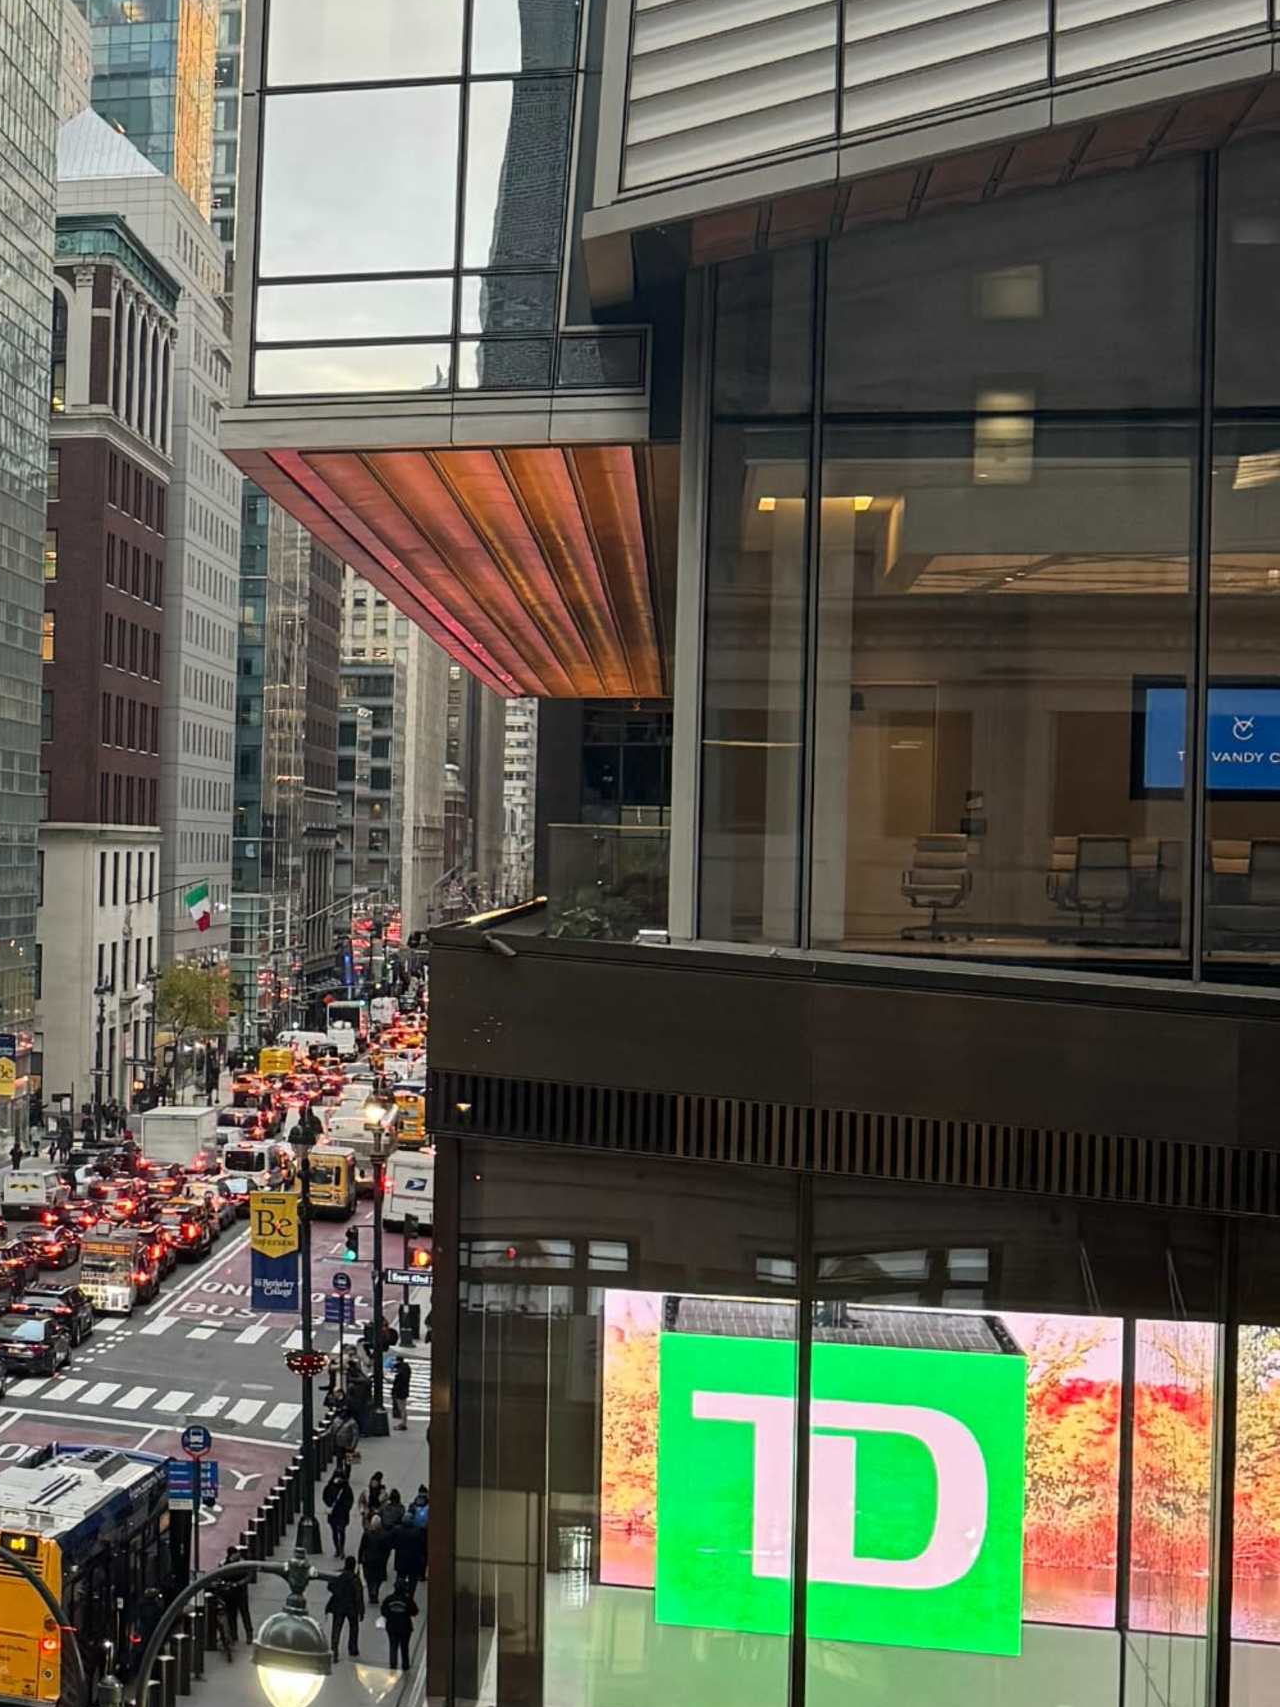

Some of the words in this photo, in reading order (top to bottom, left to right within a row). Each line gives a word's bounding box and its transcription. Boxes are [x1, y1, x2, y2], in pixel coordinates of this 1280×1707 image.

[1211, 751, 1264, 763] VANDY
[256, 1209, 293, 1238] Be
[180, 1302, 257, 1319] BUS
[692, 1390, 989, 1590] TD
